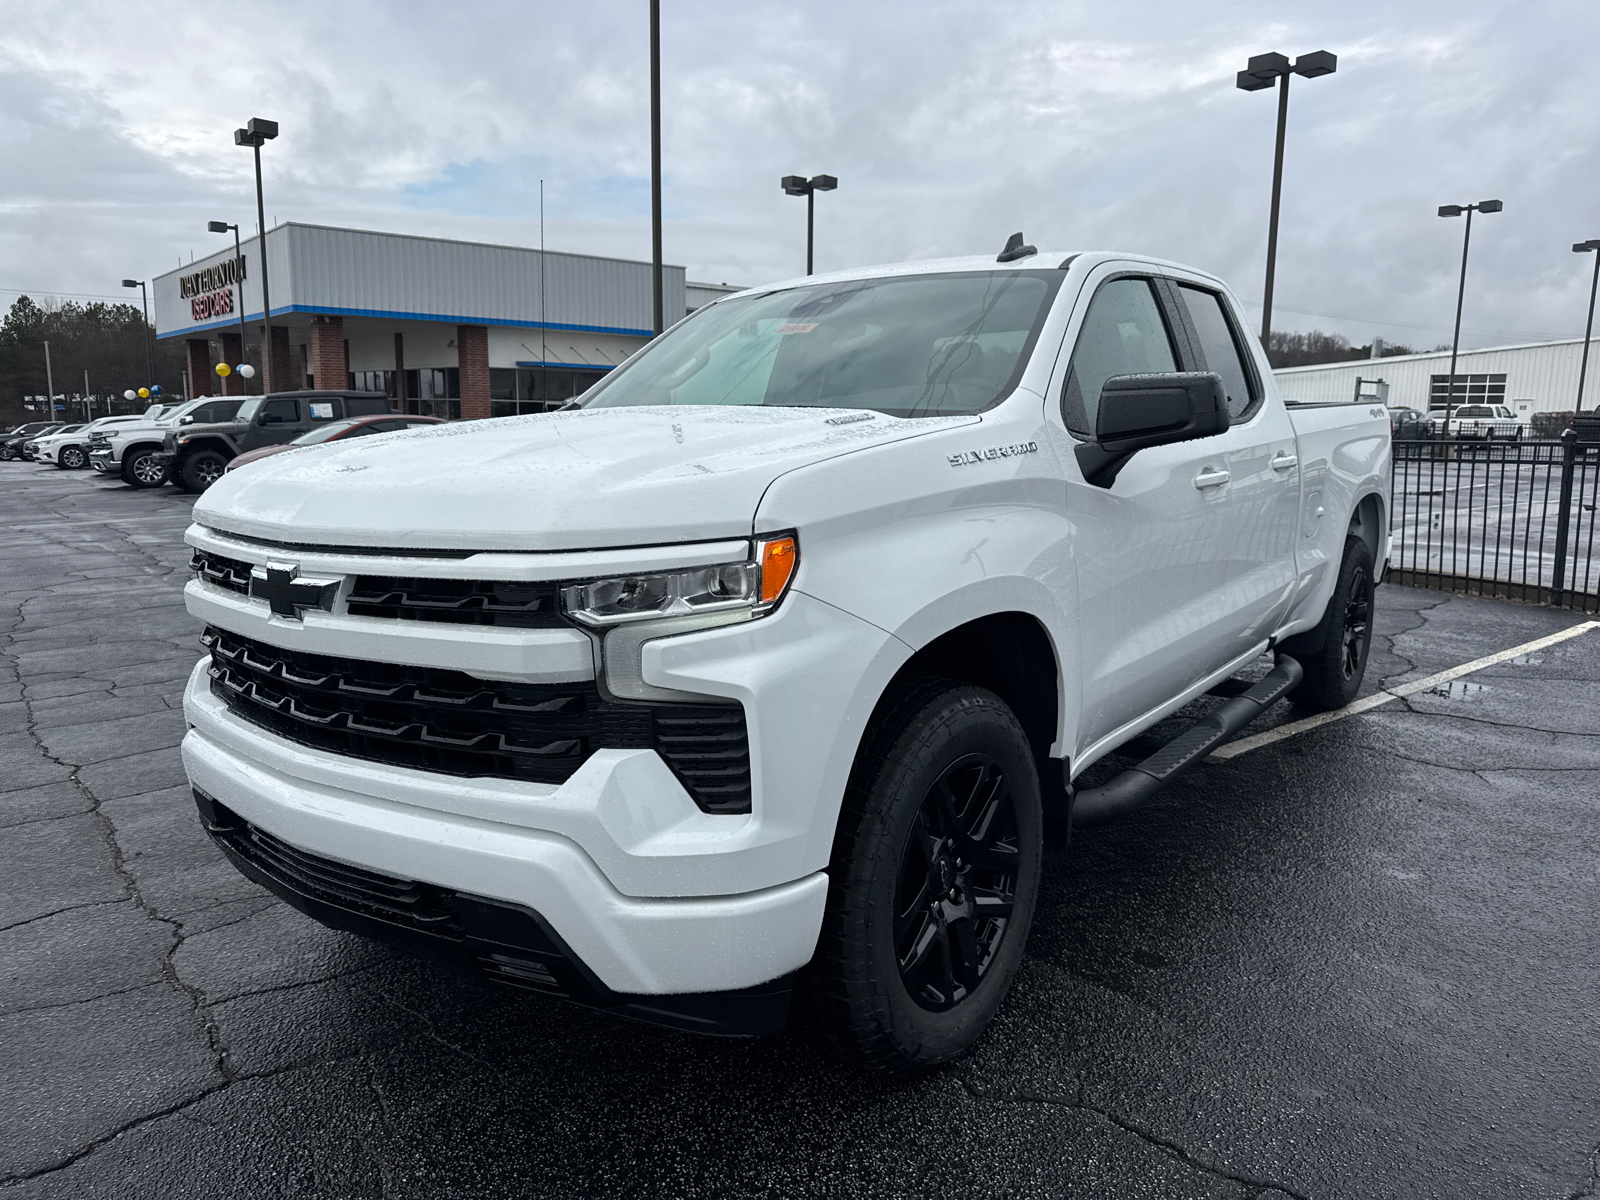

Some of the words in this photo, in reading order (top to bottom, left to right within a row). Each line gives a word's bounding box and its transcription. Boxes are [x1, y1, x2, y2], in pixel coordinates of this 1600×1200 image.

[180, 272, 199, 299] JOHN
[191, 295, 211, 321] USED
[209, 289, 234, 316] CARS
[946, 441, 1038, 467] SILVERADO
